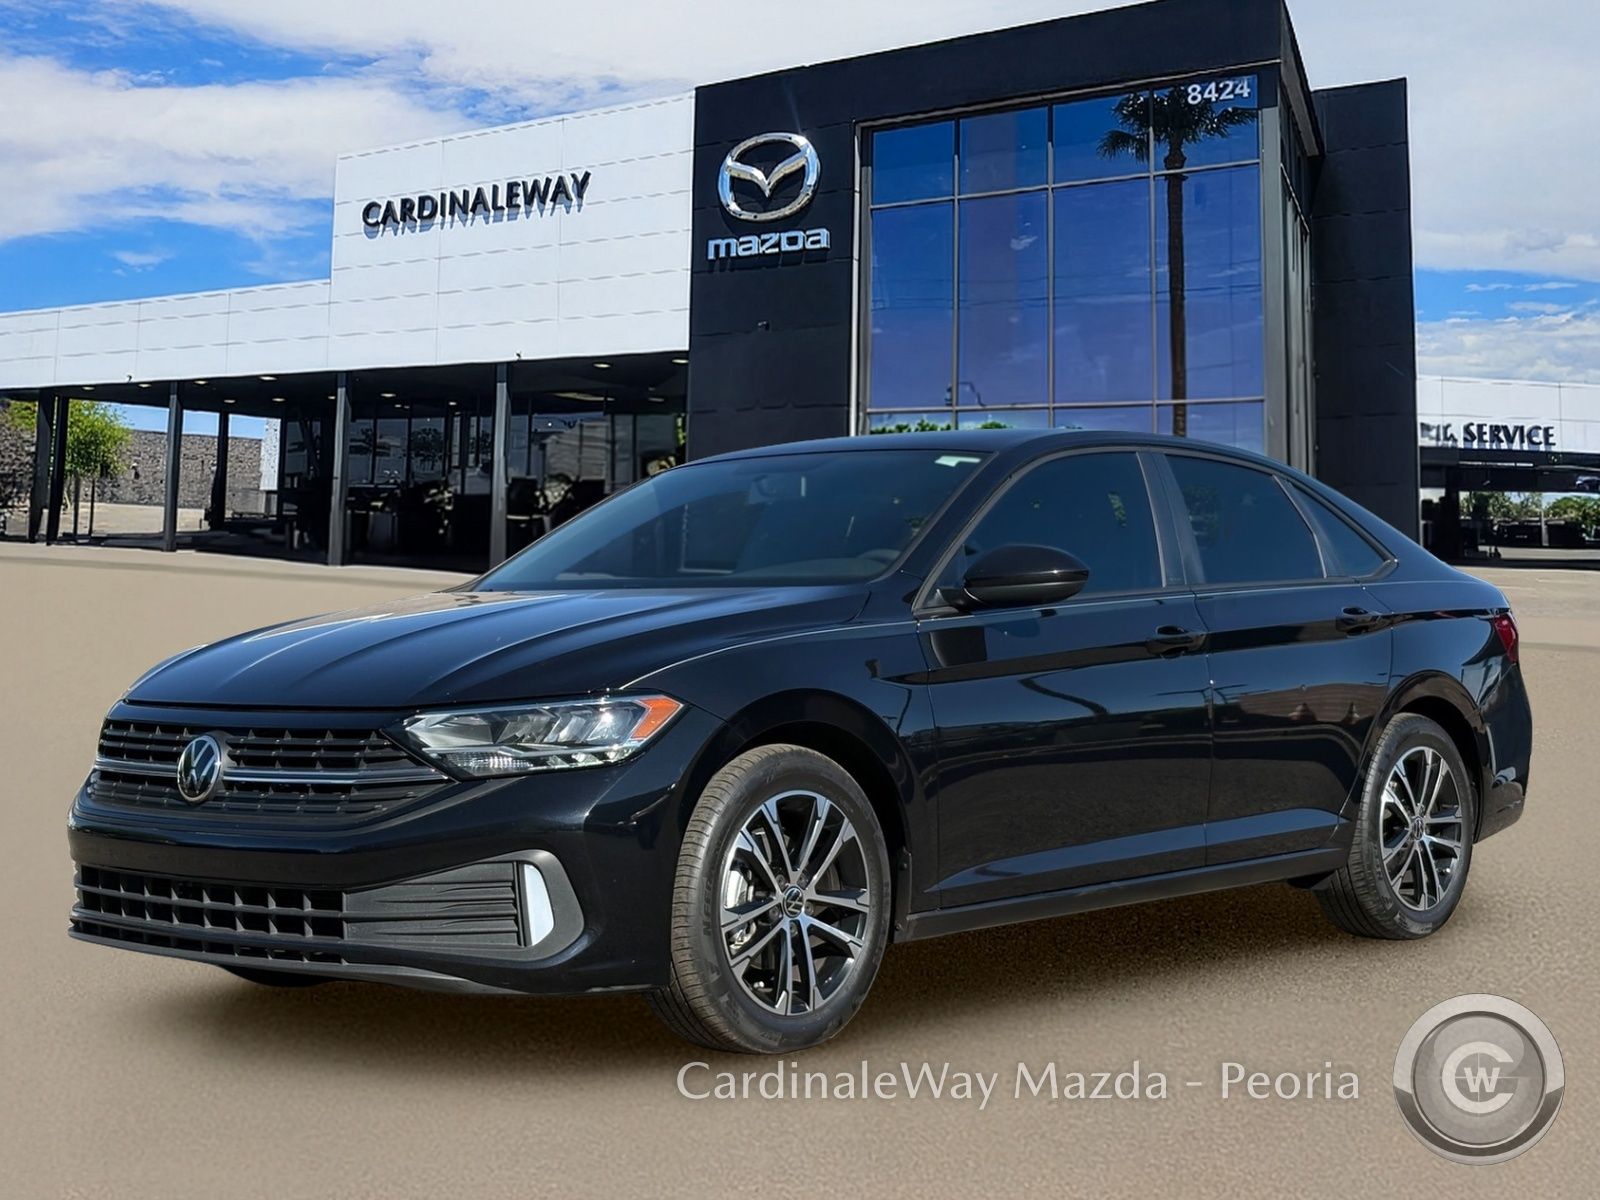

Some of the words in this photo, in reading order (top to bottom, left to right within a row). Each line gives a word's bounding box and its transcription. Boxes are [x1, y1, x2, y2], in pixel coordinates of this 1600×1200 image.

[1187, 78, 1251, 105] 8424
[362, 170, 592, 227] CARDINALEWAY
[1462, 422, 1557, 446] SERVICE
